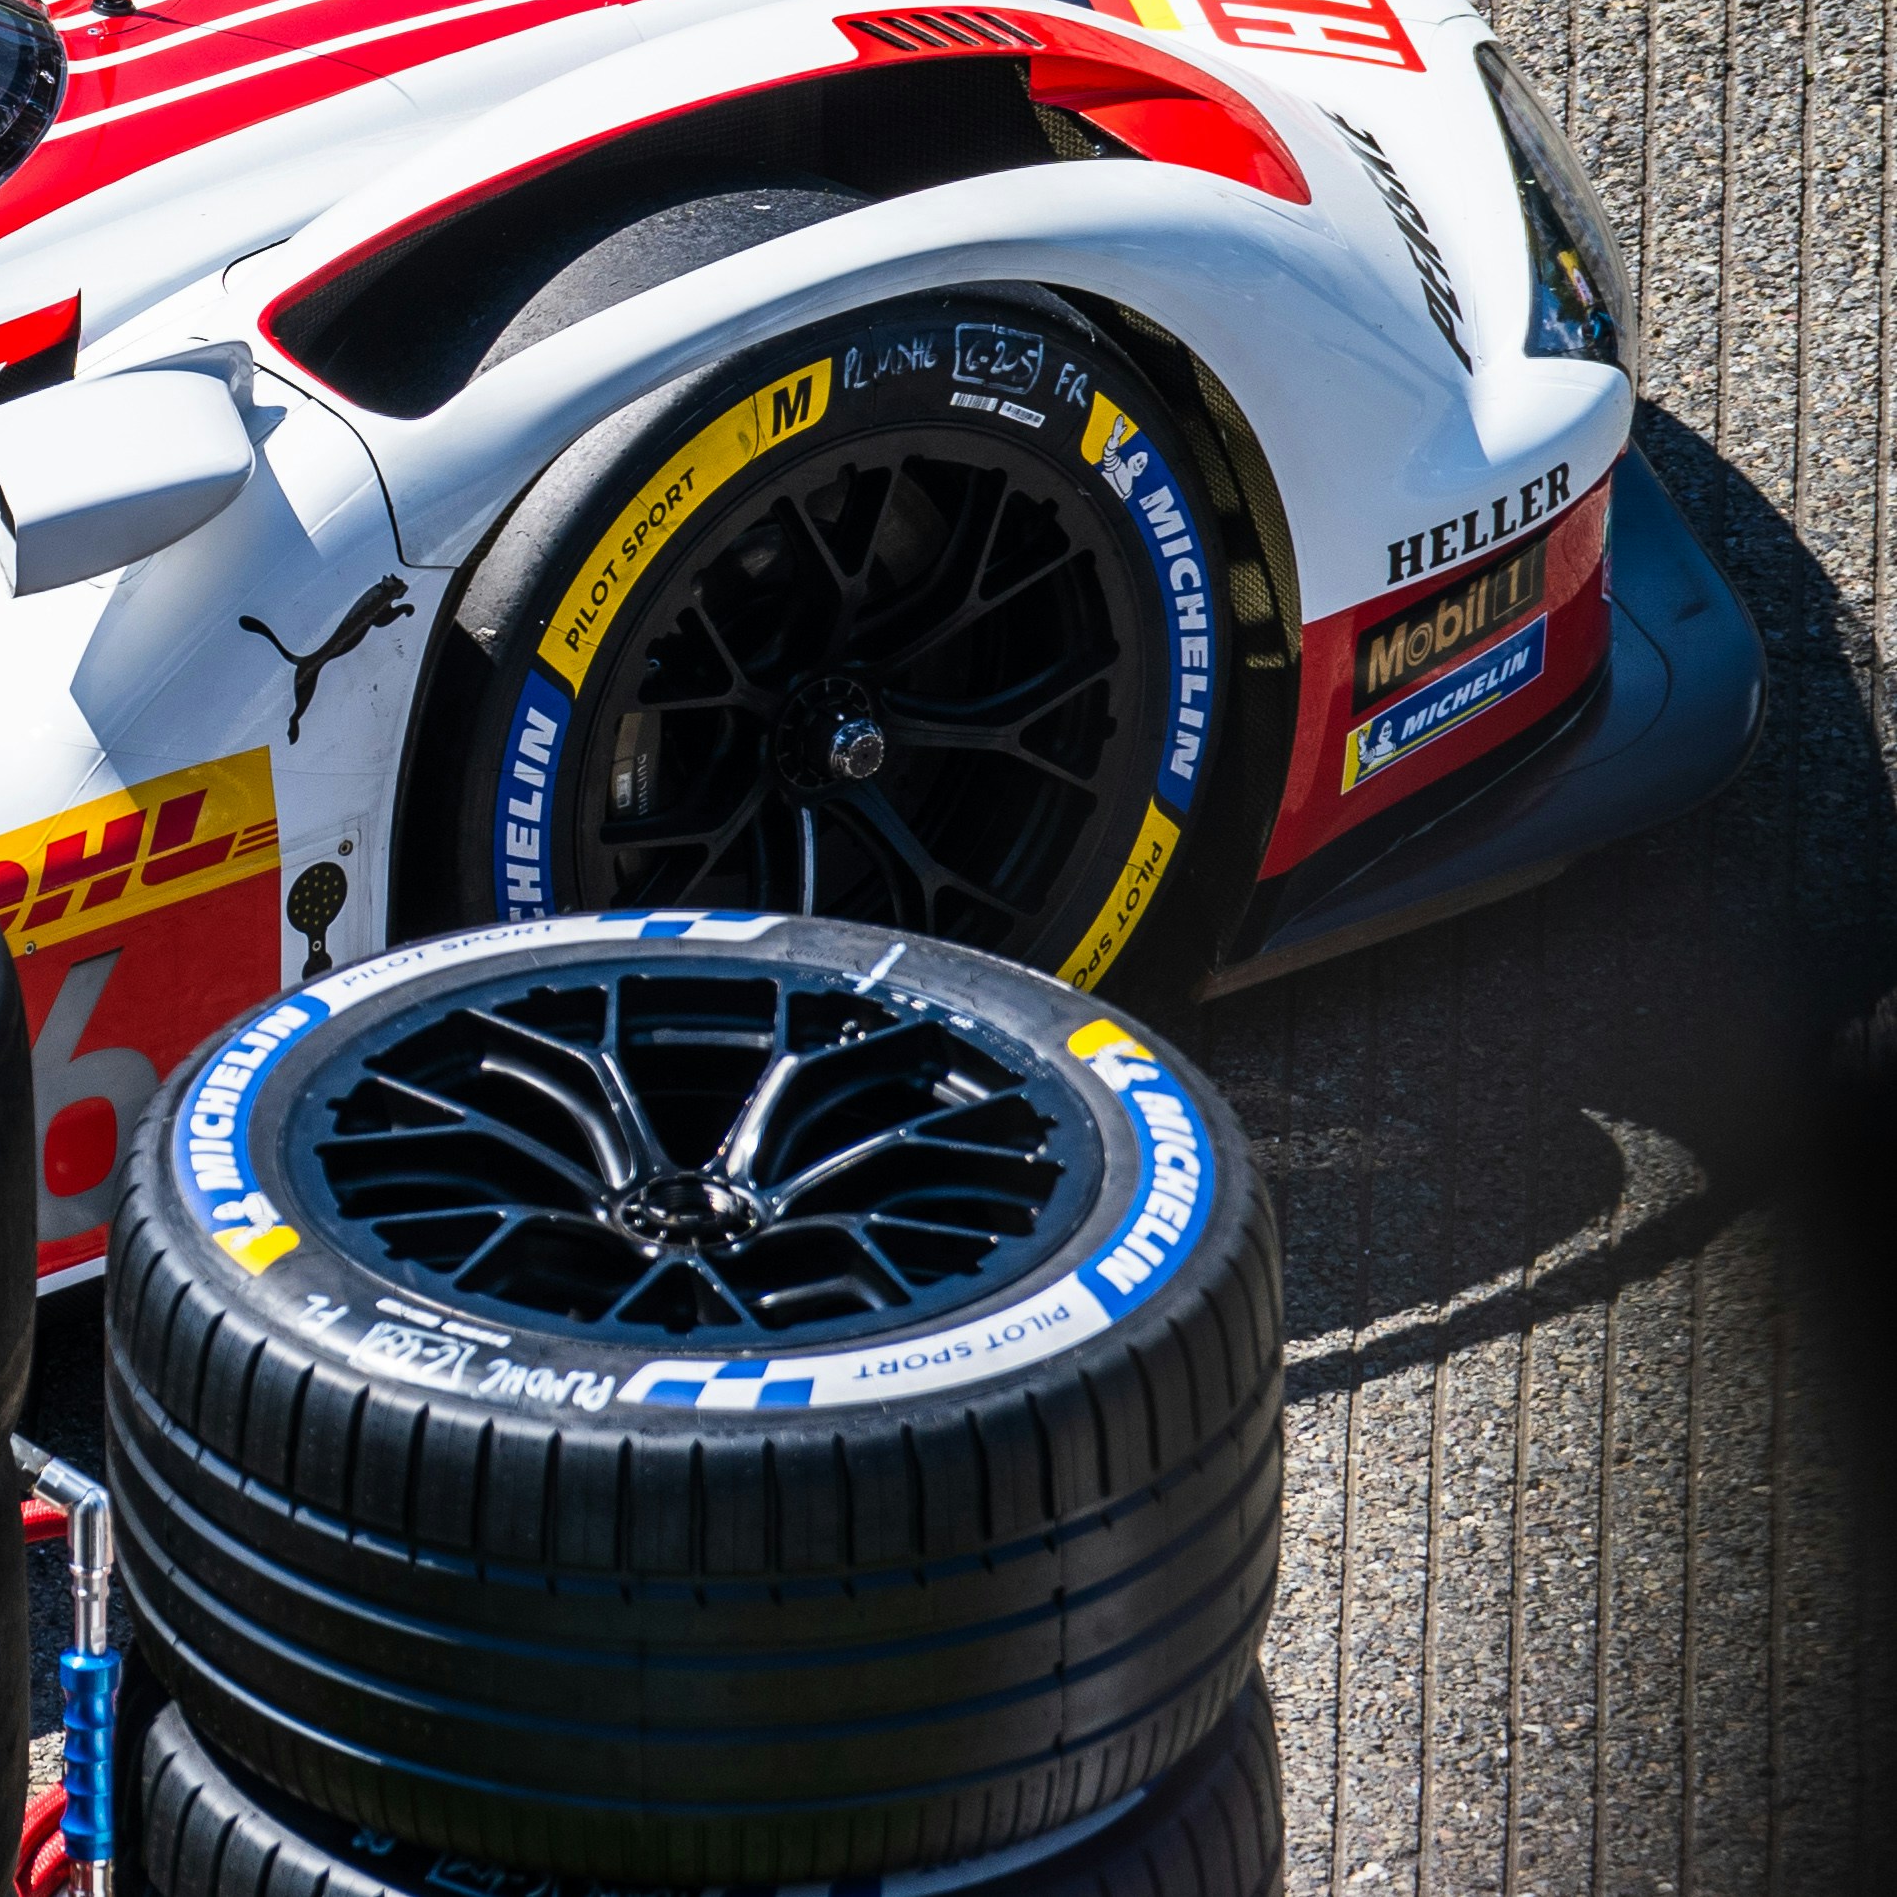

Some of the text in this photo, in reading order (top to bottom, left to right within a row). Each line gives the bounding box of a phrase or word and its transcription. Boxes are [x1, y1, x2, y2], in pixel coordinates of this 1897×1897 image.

[1311, 99, 1475, 379] PENSKE
[1055, 362, 1089, 408] FR
[563, 374, 814, 654] PILOT SPORT M
[1386, 461, 1572, 587] HELLER
[1140, 482, 1210, 783] MICHELIN
[1366, 560, 1524, 695] Mobil 1
[1400, 645, 1530, 741] MICHELIN
[1115, 838, 1164, 933] PILOT
[341, 920, 555, 989] PILOT SPORT
[33, 951, 166, 1242] 6
[188, 1004, 310, 1189] MICHELIN
[1094, 1090, 1202, 1297] MICHELIN
[853, 1302, 1072, 1382] PILOT SPORT
